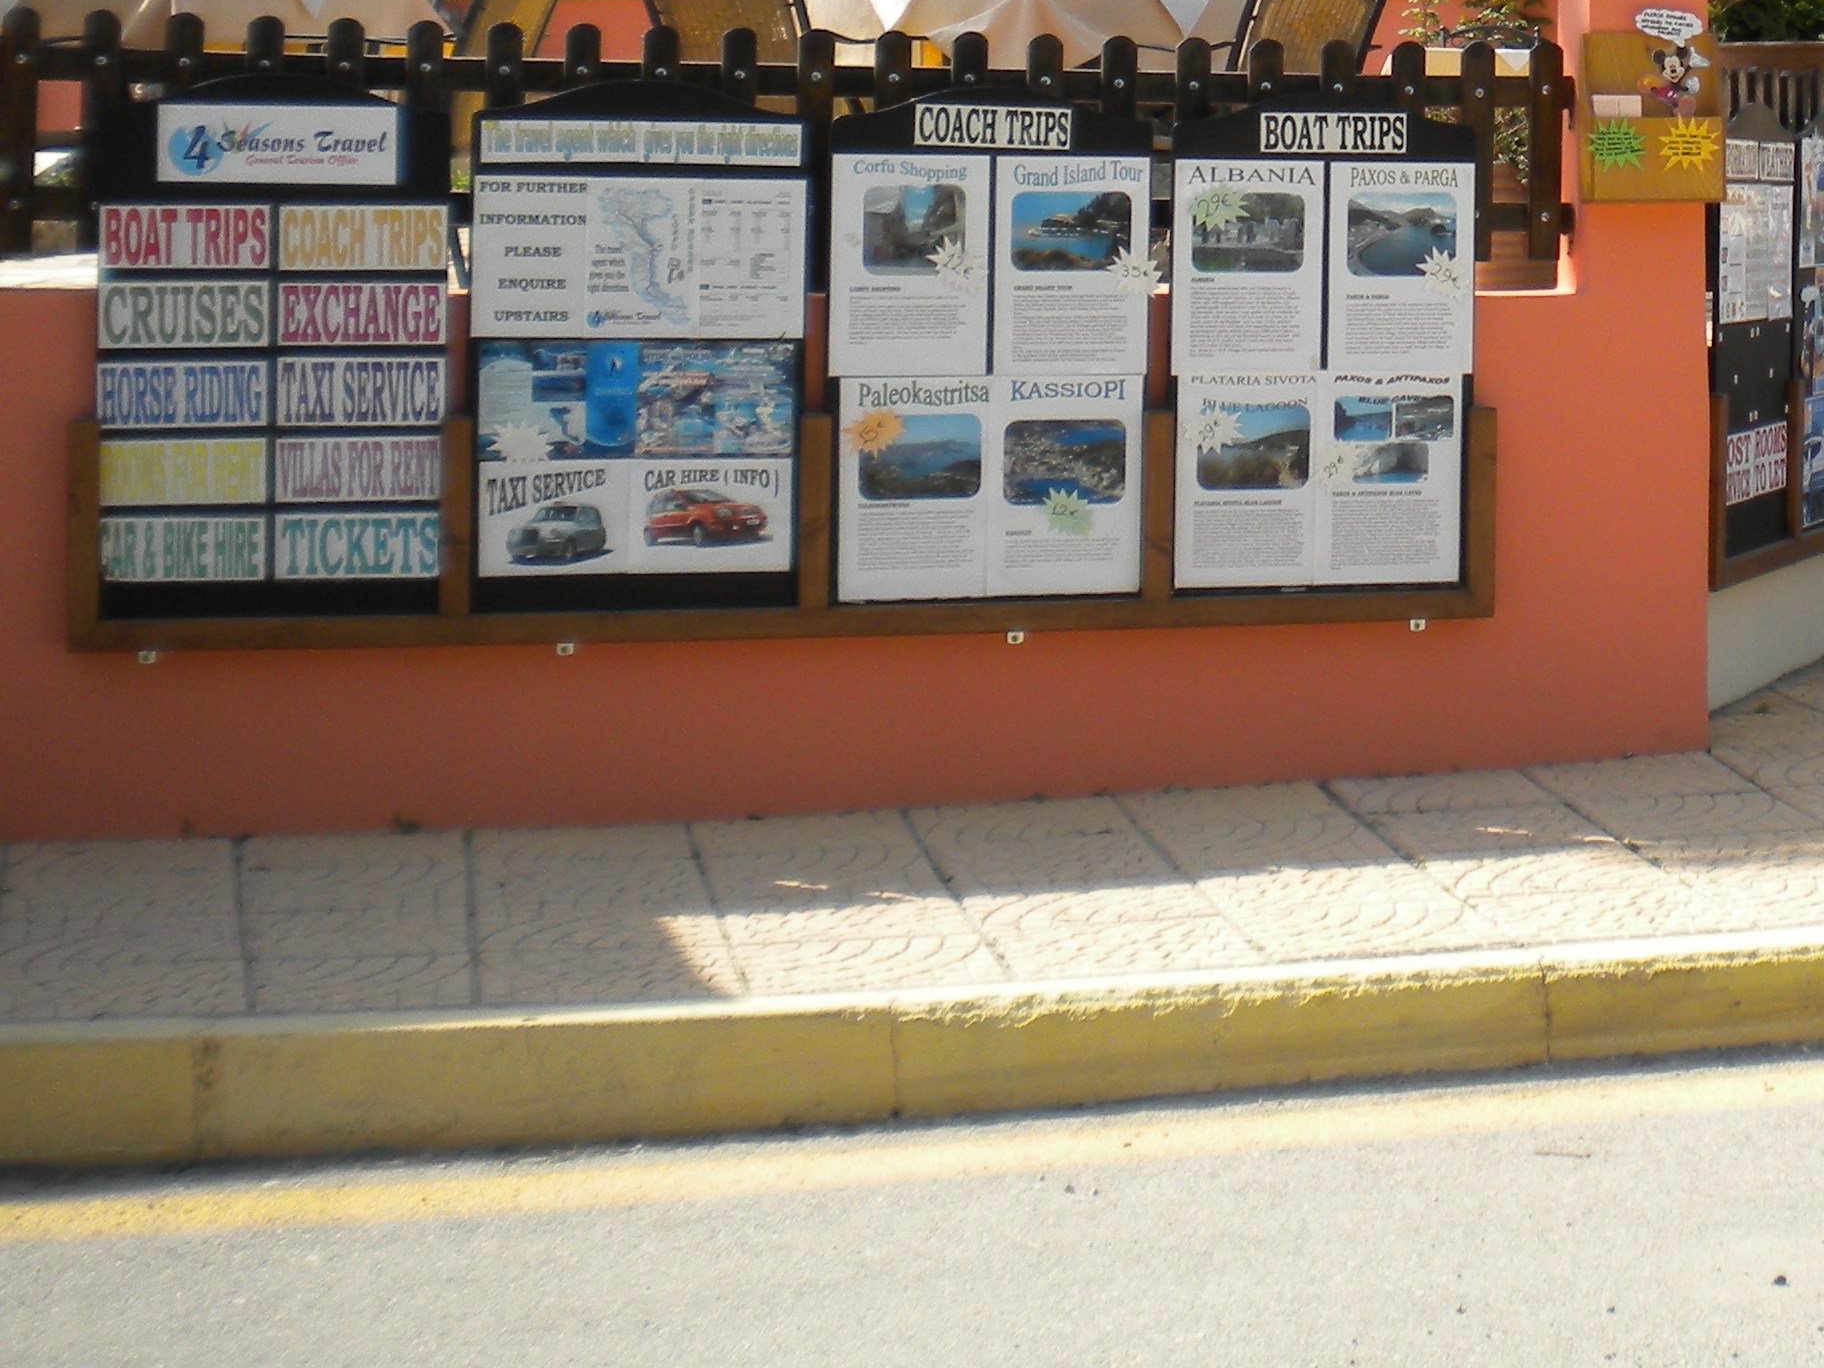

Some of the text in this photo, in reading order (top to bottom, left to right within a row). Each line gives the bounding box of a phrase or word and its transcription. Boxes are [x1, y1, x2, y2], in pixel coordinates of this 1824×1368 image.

[918, 106, 1069, 147] COACH TRIPS
[1264, 115, 1405, 152] BOAT TRIPS
[183, 124, 387, 170] 4 Seasons Travel
[853, 159, 967, 182] Corfu Shopping
[1013, 160, 1145, 186] Grand Island Tour
[1188, 165, 1316, 186] ALBANIA
[1350, 167, 1459, 188] PAXOS & PARGA
[479, 182, 588, 194] FOR FURTHER
[479, 213, 587, 226] INFORMATION
[104, 208, 267, 266] BOAT TRIPS
[283, 208, 443, 268] COACH TRIPS
[504, 246, 562, 258] PLEASE
[498, 278, 567, 291] ENQUIRE
[104, 285, 264, 345] CRUISES
[280, 285, 441, 343] EXCHANGE
[494, 310, 569, 323] UPSTAIRS
[283, 362, 336, 423] TAXI
[343, 361, 440, 423] SERVICE
[1010, 379, 1126, 402] KASSIOPI
[1190, 375, 1317, 386] PLATARIA SIVOTA
[1333, 375, 1373, 385] PAXOS
[1386, 374, 1450, 385] ANTIPAXOS
[101, 365, 263, 425] HORSE RIDING
[858, 380, 990, 407] Paleokastritsa
[1245, 397, 1308, 413] LAGOON
[1727, 434, 1751, 468] OST
[280, 440, 439, 498] VILLAS FOR RENT
[643, 470, 675, 492] CAR
[680, 469, 720, 483] HIRE
[487, 468, 608, 517] TAXI SERVICE
[163, 520, 208, 578] BIKE
[215, 520, 259, 578] HIRE
[281, 518, 439, 576] TICKETS
